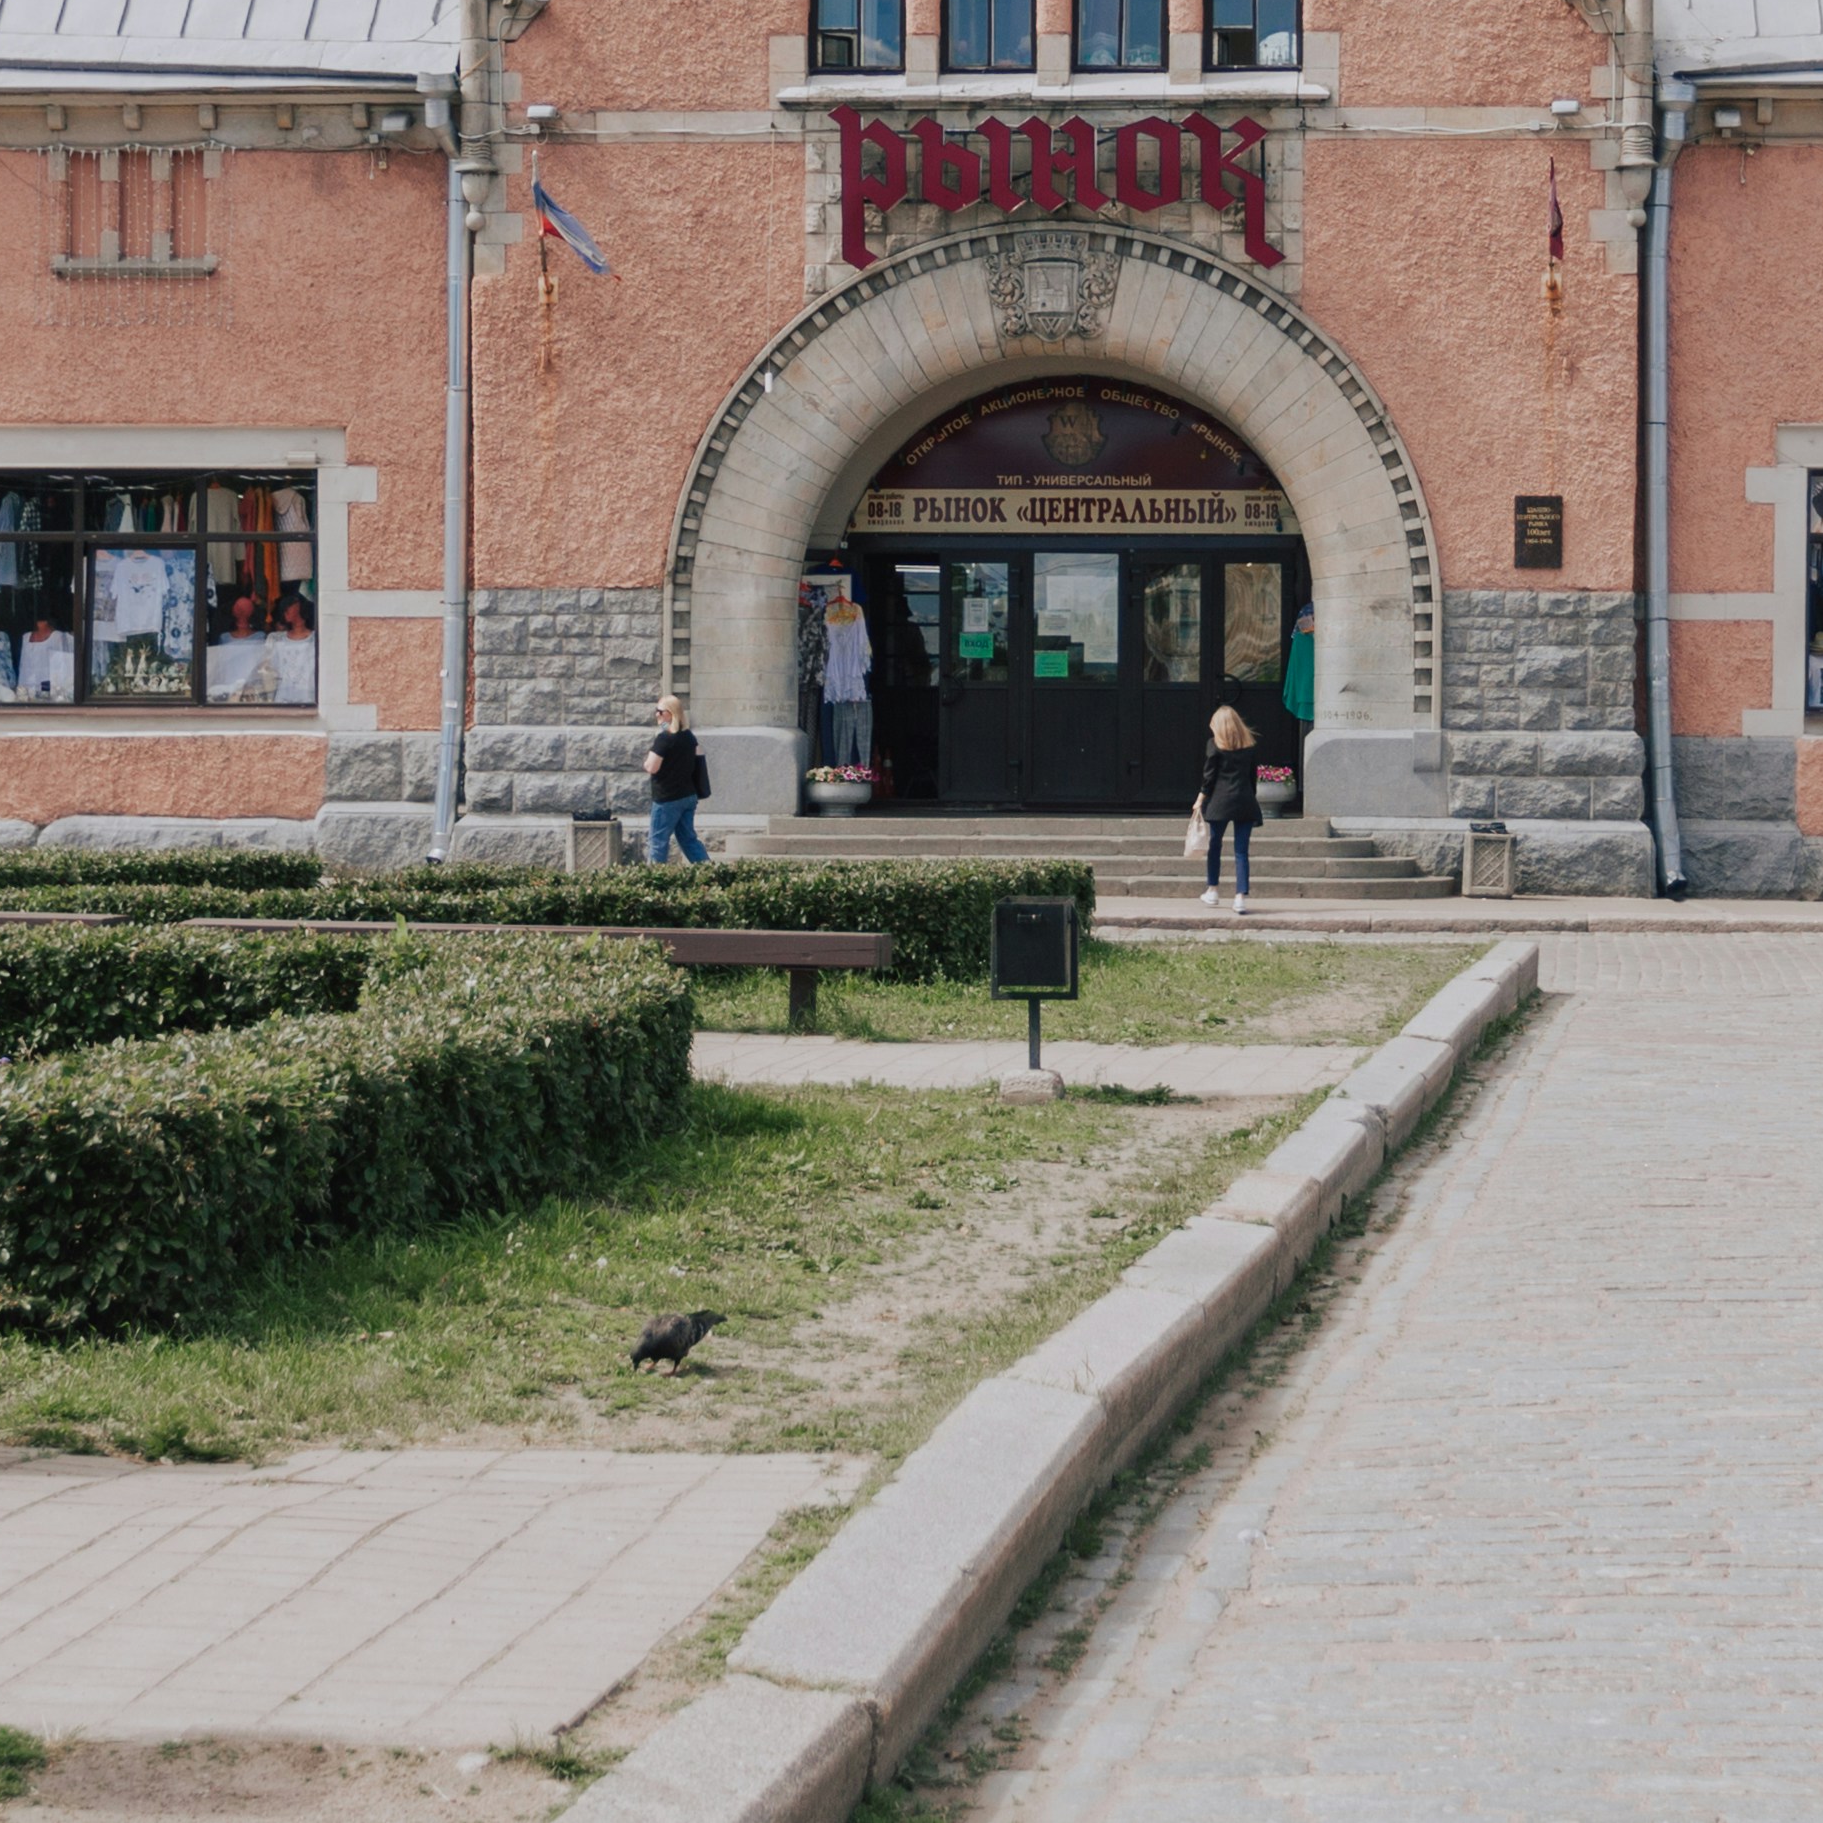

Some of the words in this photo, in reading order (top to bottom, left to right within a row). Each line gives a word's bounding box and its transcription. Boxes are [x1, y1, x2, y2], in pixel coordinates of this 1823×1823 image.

[980, 386, 1085, 416] АКЦИОНЕРНОЕ
[1100, 388, 1180, 419] ОБЩЕСТВО
[1191, 422, 1242, 466] «РЫНОК
[996, 474, 1023, 486] ТИП
[1033, 473, 1152, 486] УНИВЕРСАЛЬНЫЙ
[912, 496, 1008, 523] РЫНОК
[1016, 491, 1237, 526] «ЦЕНТРАЛЬНЫЙ»
[964, 639, 990, 648] ВХОД
